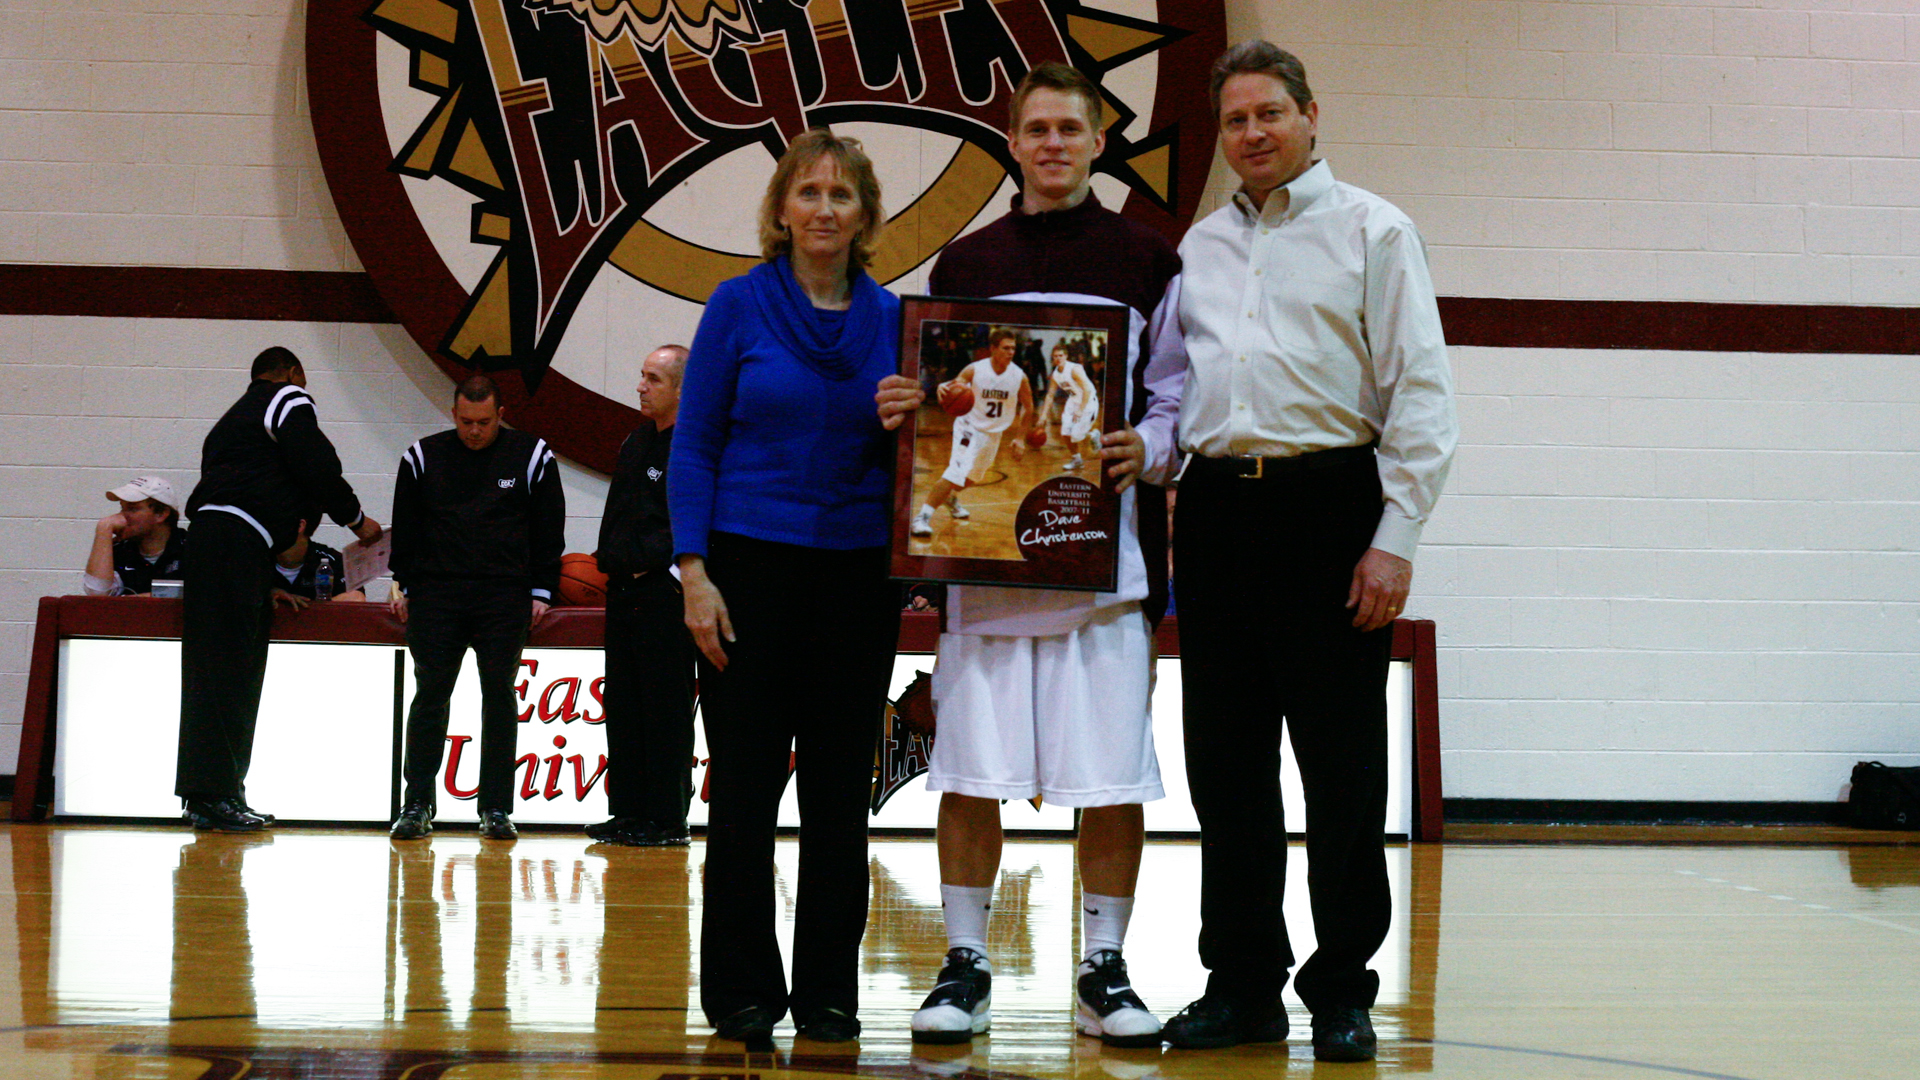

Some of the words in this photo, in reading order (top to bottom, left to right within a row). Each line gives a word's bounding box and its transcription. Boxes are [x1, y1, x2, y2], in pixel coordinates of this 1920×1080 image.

[986, 402, 1003, 418] 21
[1038, 509, 1082, 527] Dave
[1020, 526, 1107, 546] Christenson
